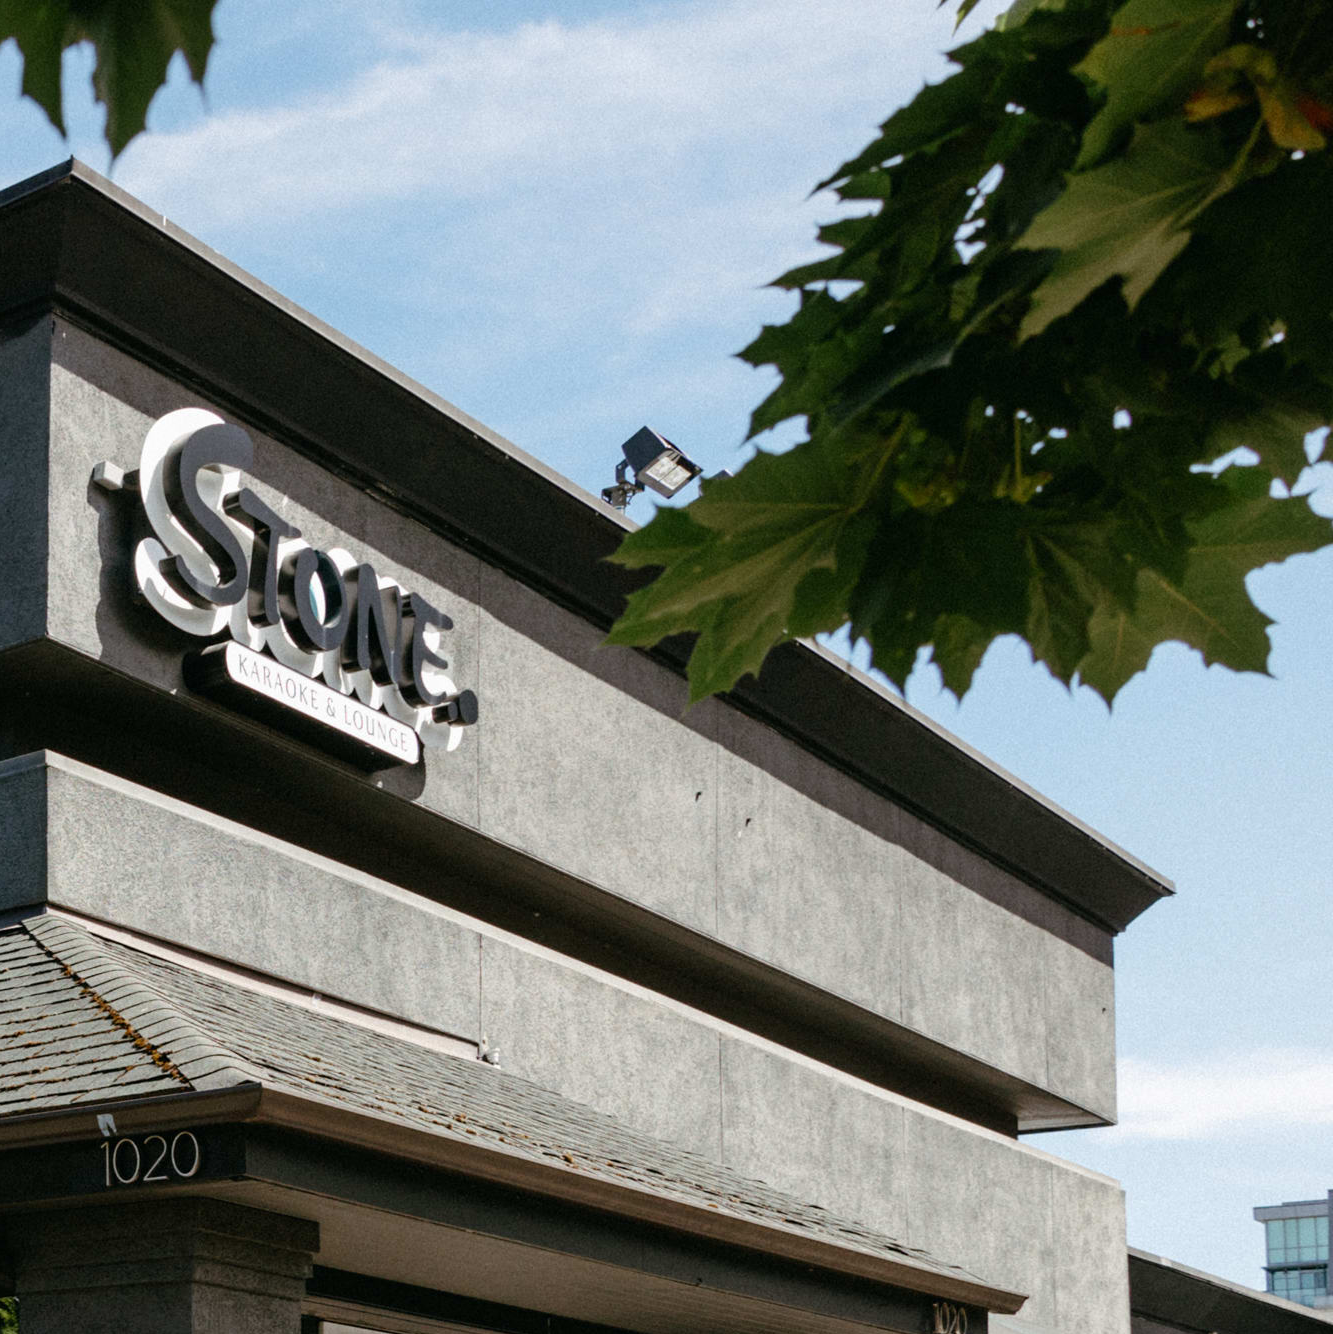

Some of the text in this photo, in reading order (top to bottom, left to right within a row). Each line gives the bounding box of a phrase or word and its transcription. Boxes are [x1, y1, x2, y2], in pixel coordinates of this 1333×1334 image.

[159, 423, 455, 708] STONE
[237, 653, 409, 752] KARAOKE & LOUNGE
[100, 1131, 200, 1187] 1020
